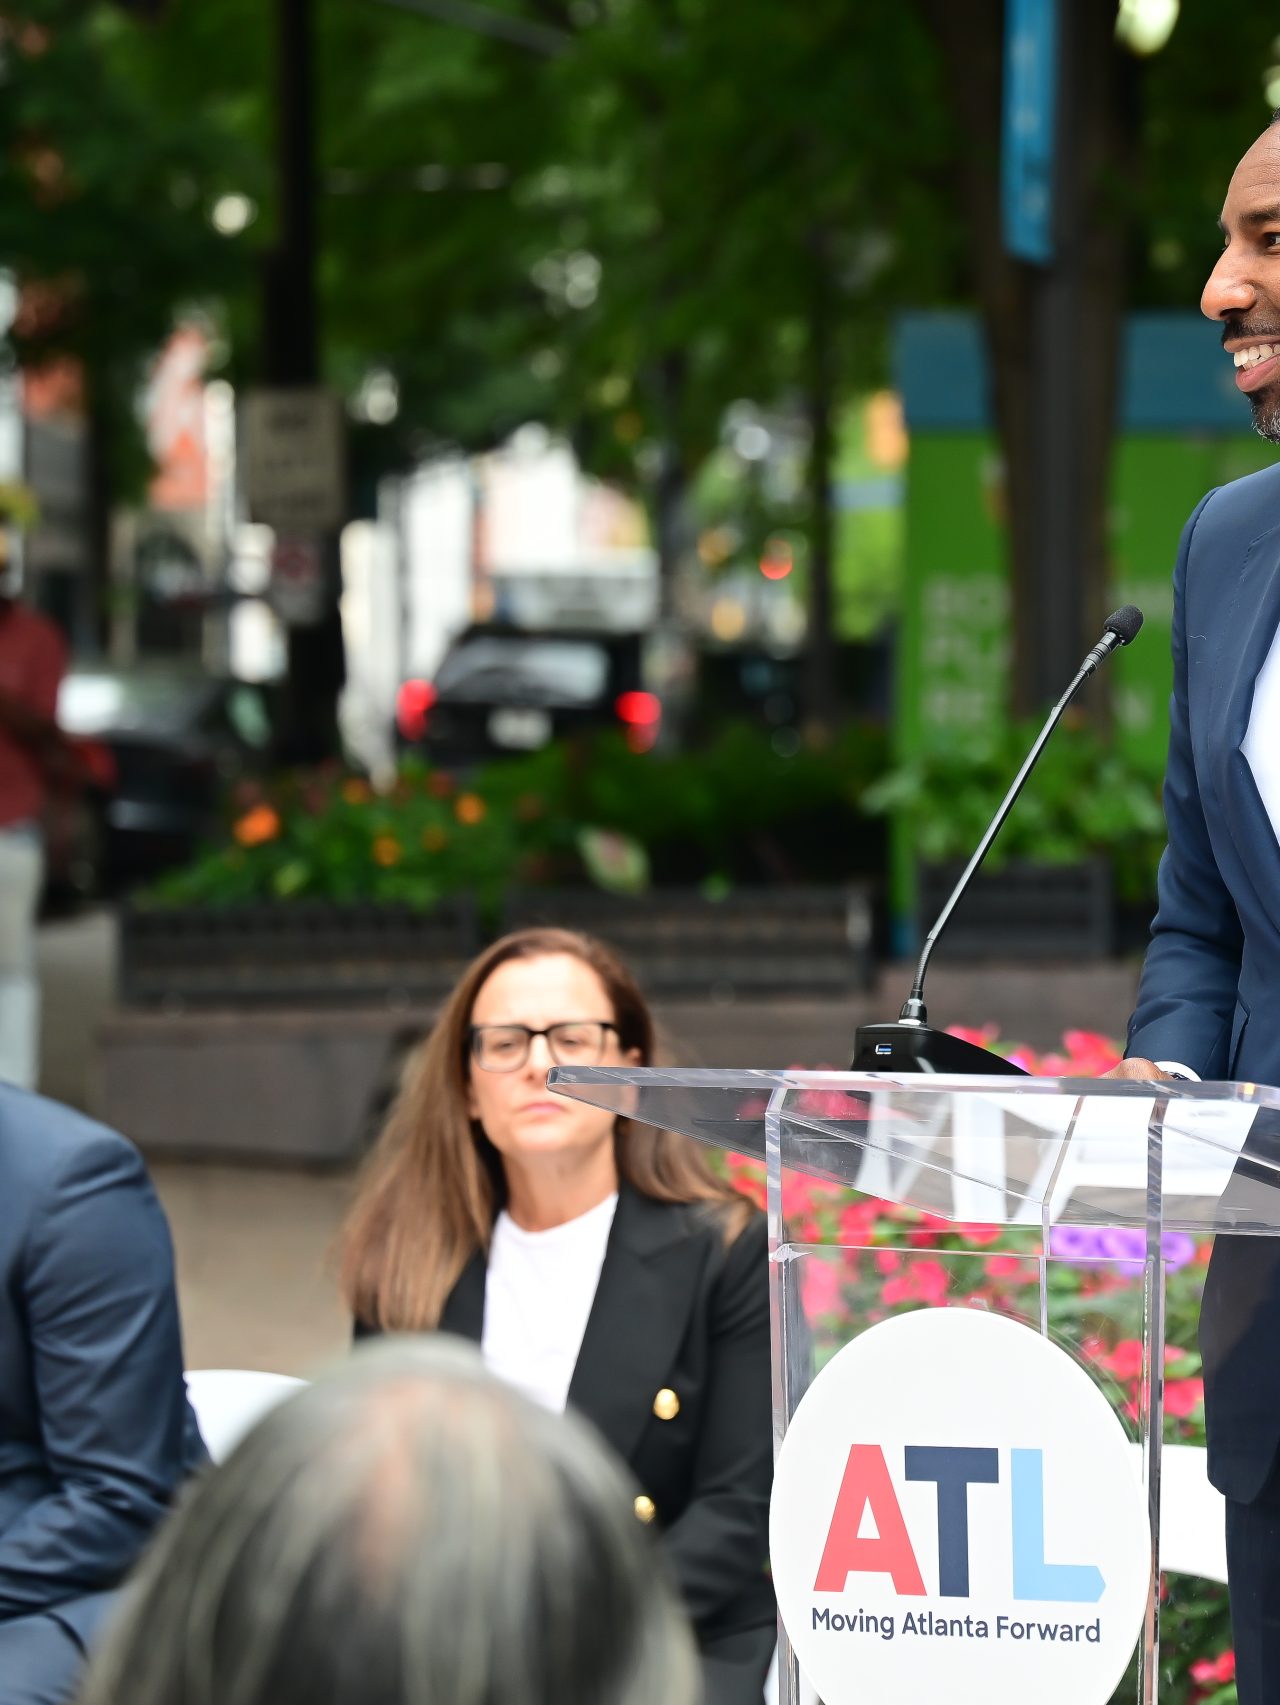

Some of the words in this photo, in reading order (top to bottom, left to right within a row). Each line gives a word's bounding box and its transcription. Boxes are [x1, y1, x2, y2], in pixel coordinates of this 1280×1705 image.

[813, 1444, 1107, 1604] ATL
[811, 1607, 895, 1641] Moving
[901, 1611, 989, 1638] Atlanta
[996, 1615, 1101, 1643] Forward
